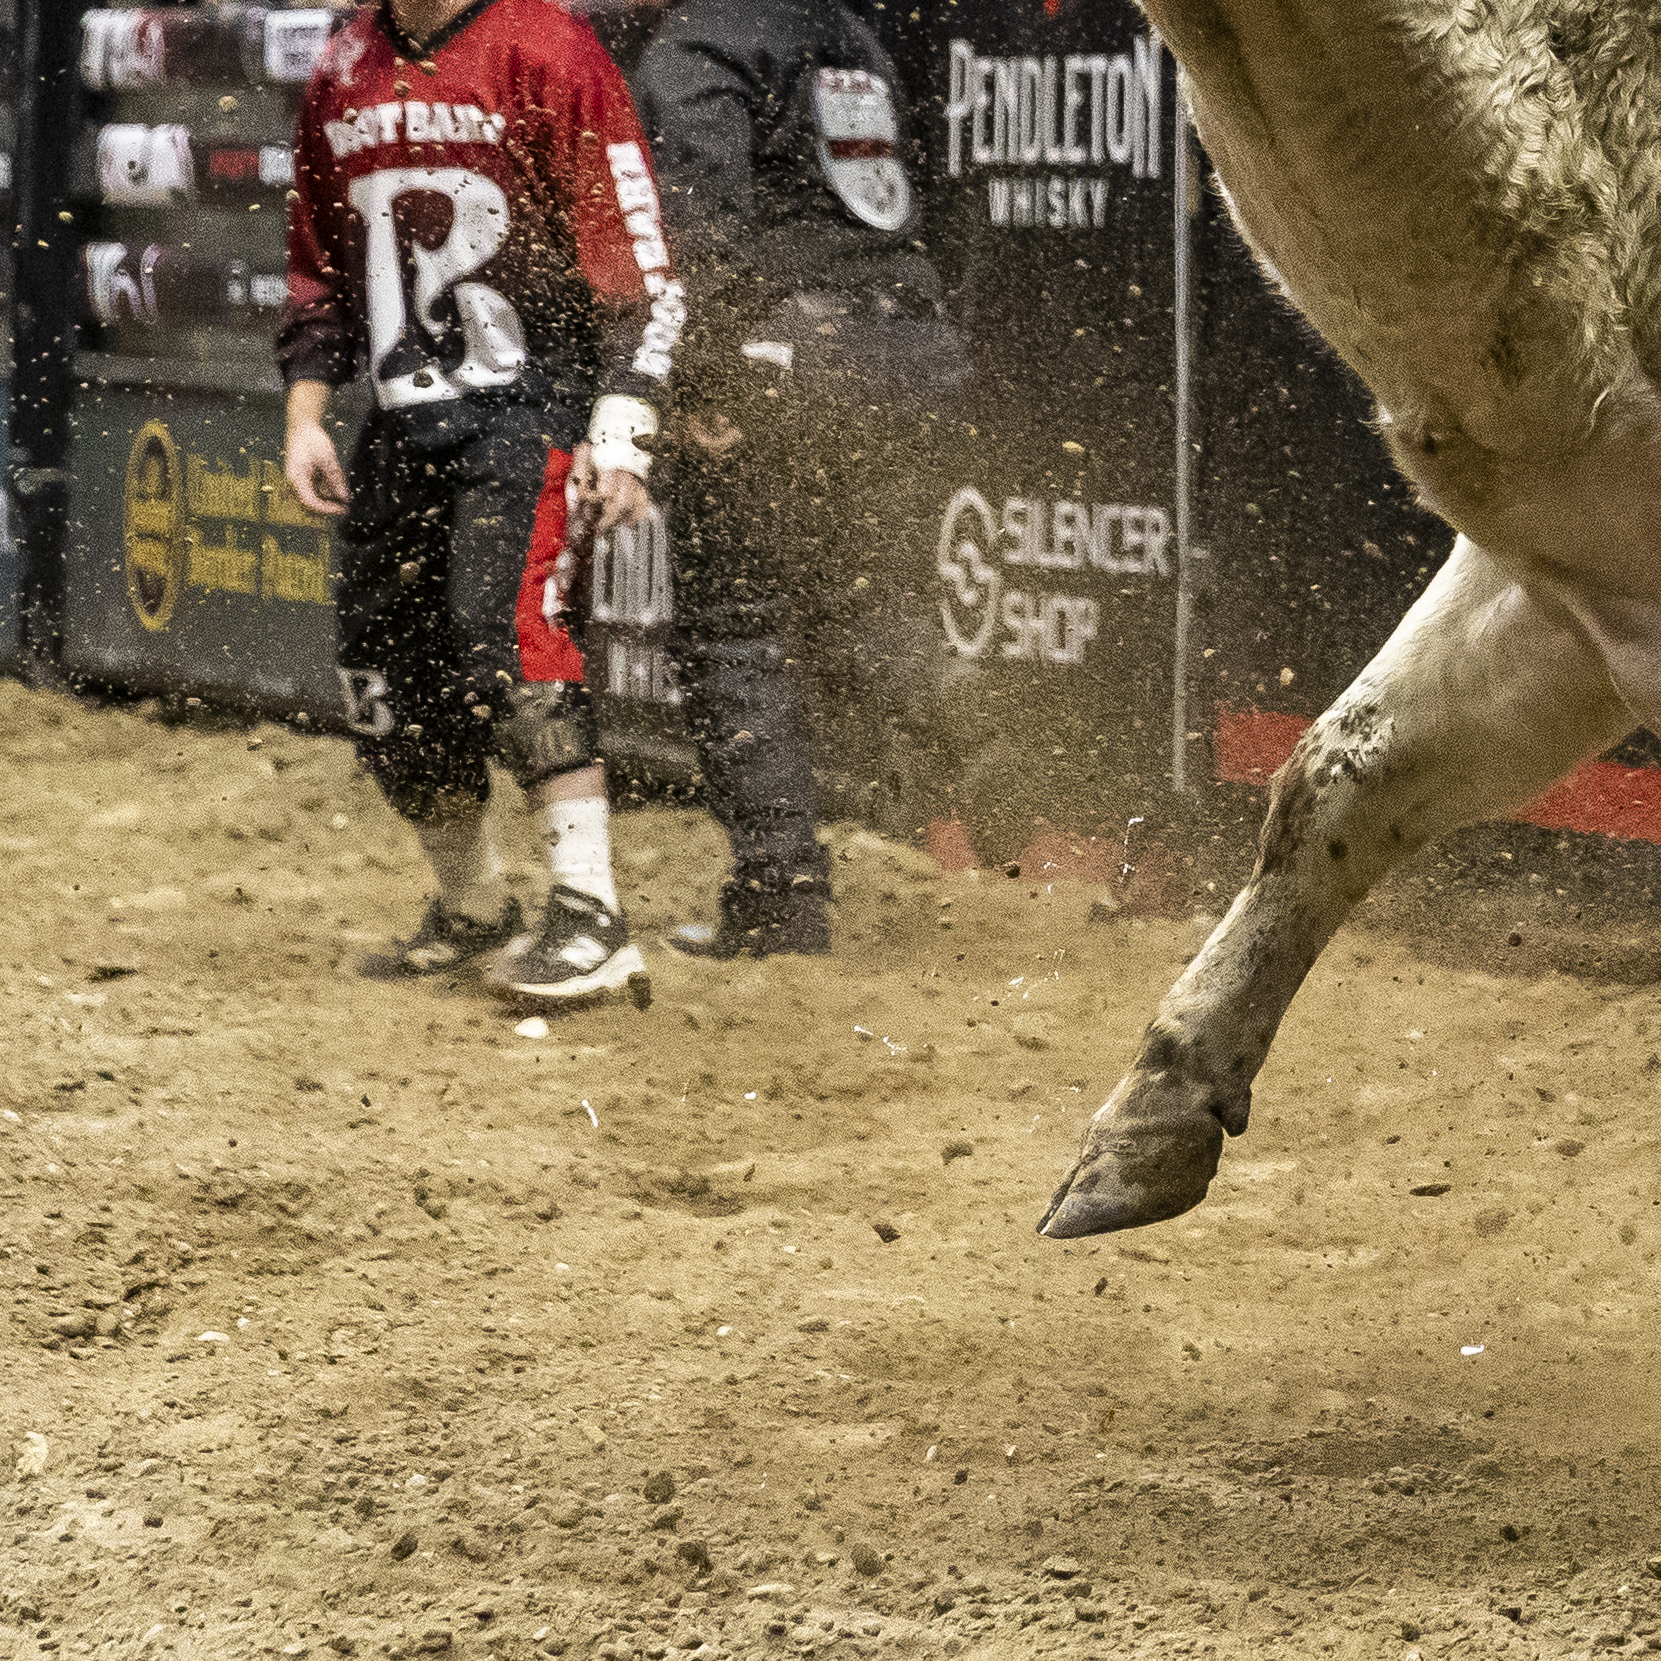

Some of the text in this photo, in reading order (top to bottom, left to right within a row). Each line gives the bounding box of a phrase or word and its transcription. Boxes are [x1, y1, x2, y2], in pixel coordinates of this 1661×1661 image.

[945, 32, 1162, 179] PENDLETON
[988, 177, 1108, 229] WHISKY
[1002, 592, 1100, 665] SHOP
